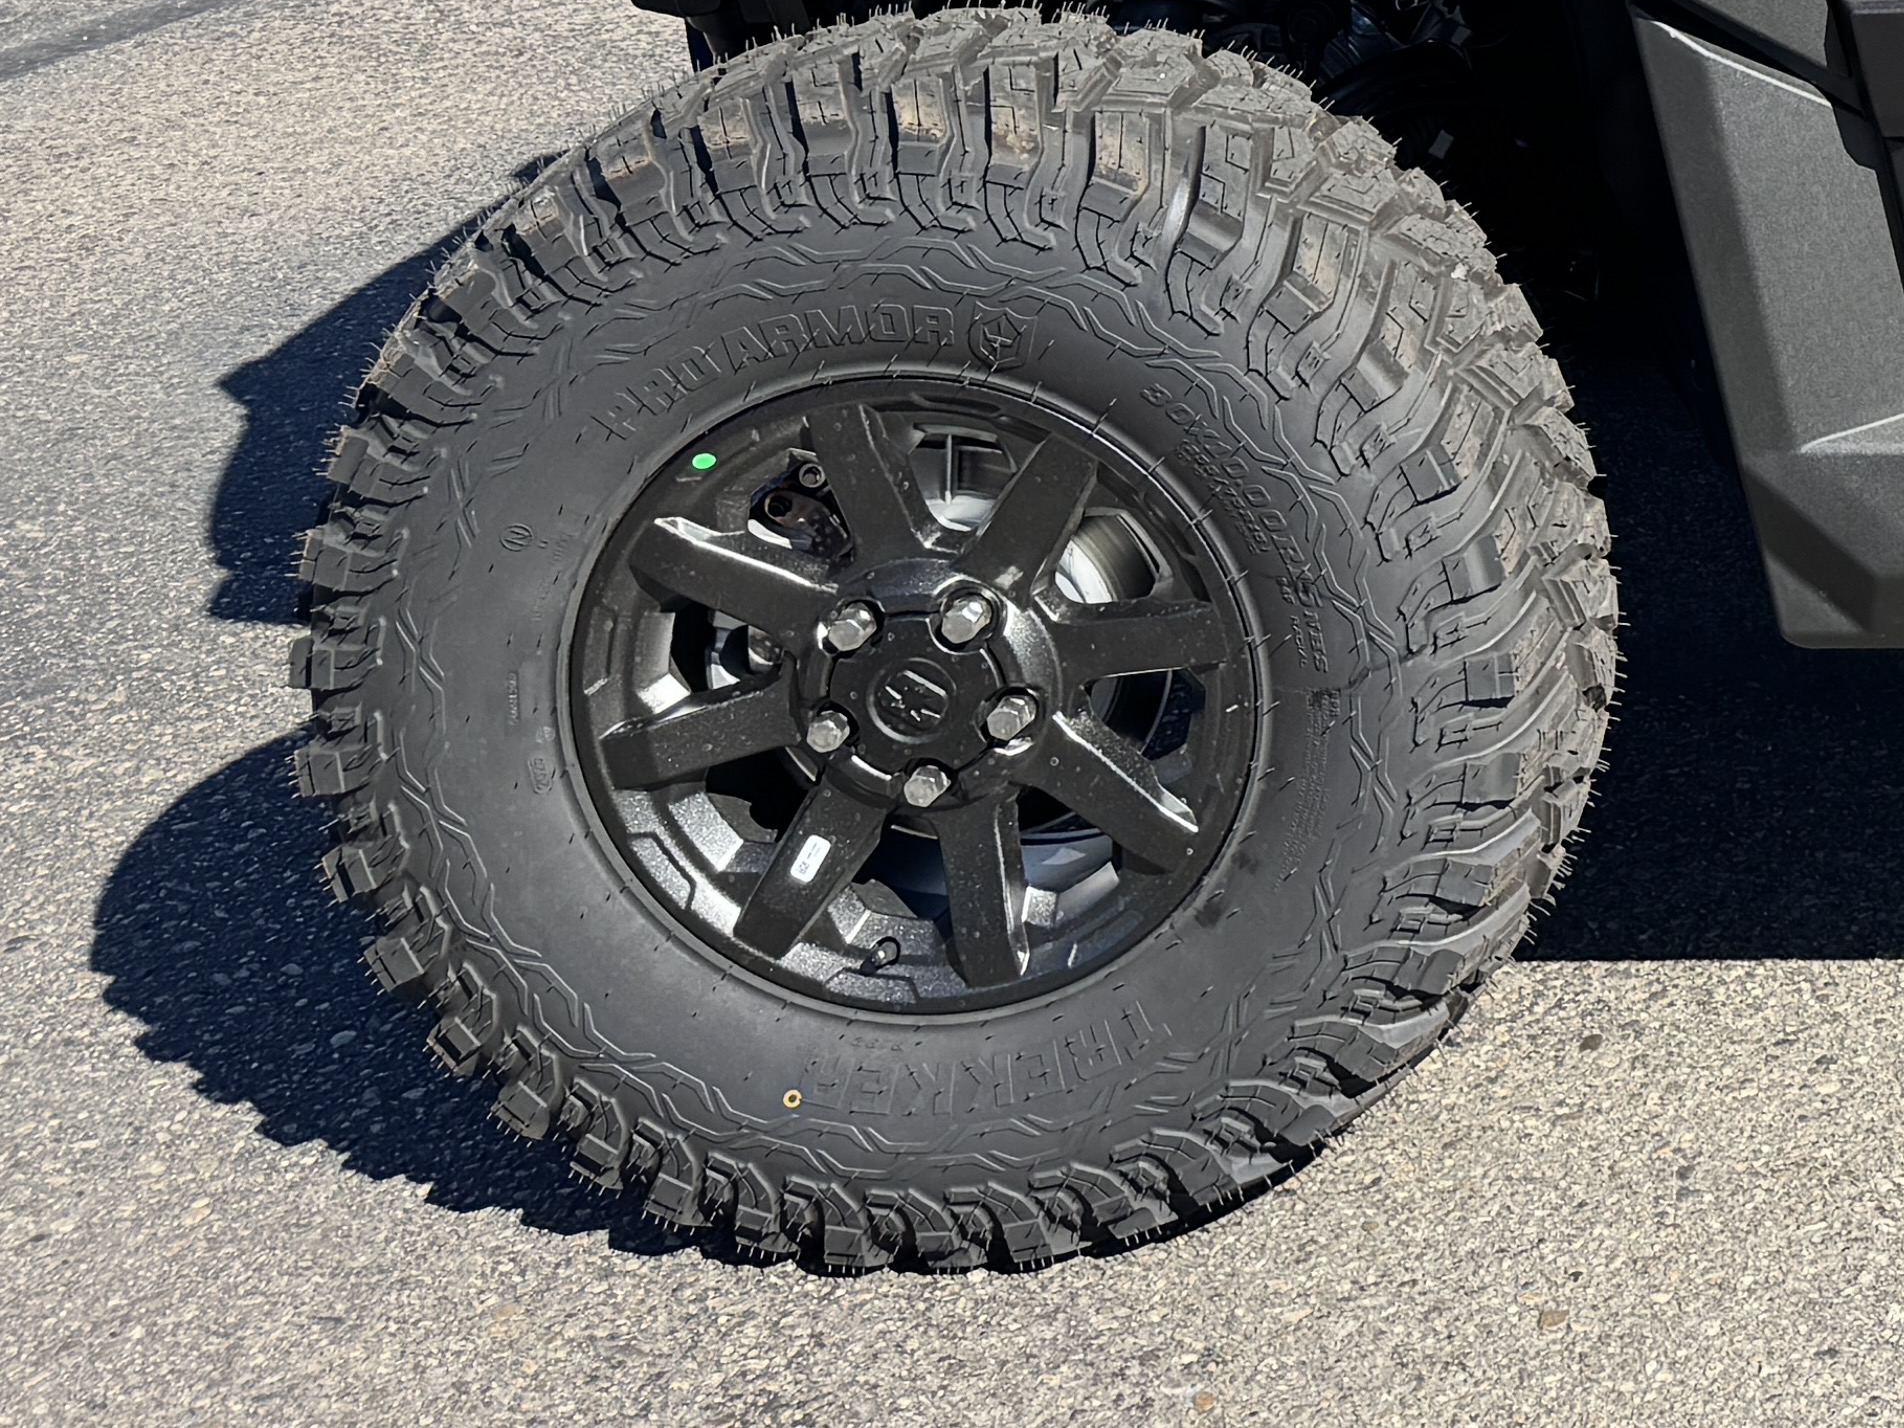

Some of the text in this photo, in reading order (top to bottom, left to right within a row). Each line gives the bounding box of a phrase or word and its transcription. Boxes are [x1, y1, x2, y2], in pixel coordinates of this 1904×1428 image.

[591, 303, 956, 442] PRO ARMOR
[803, 999, 1173, 1116] TREKKER
